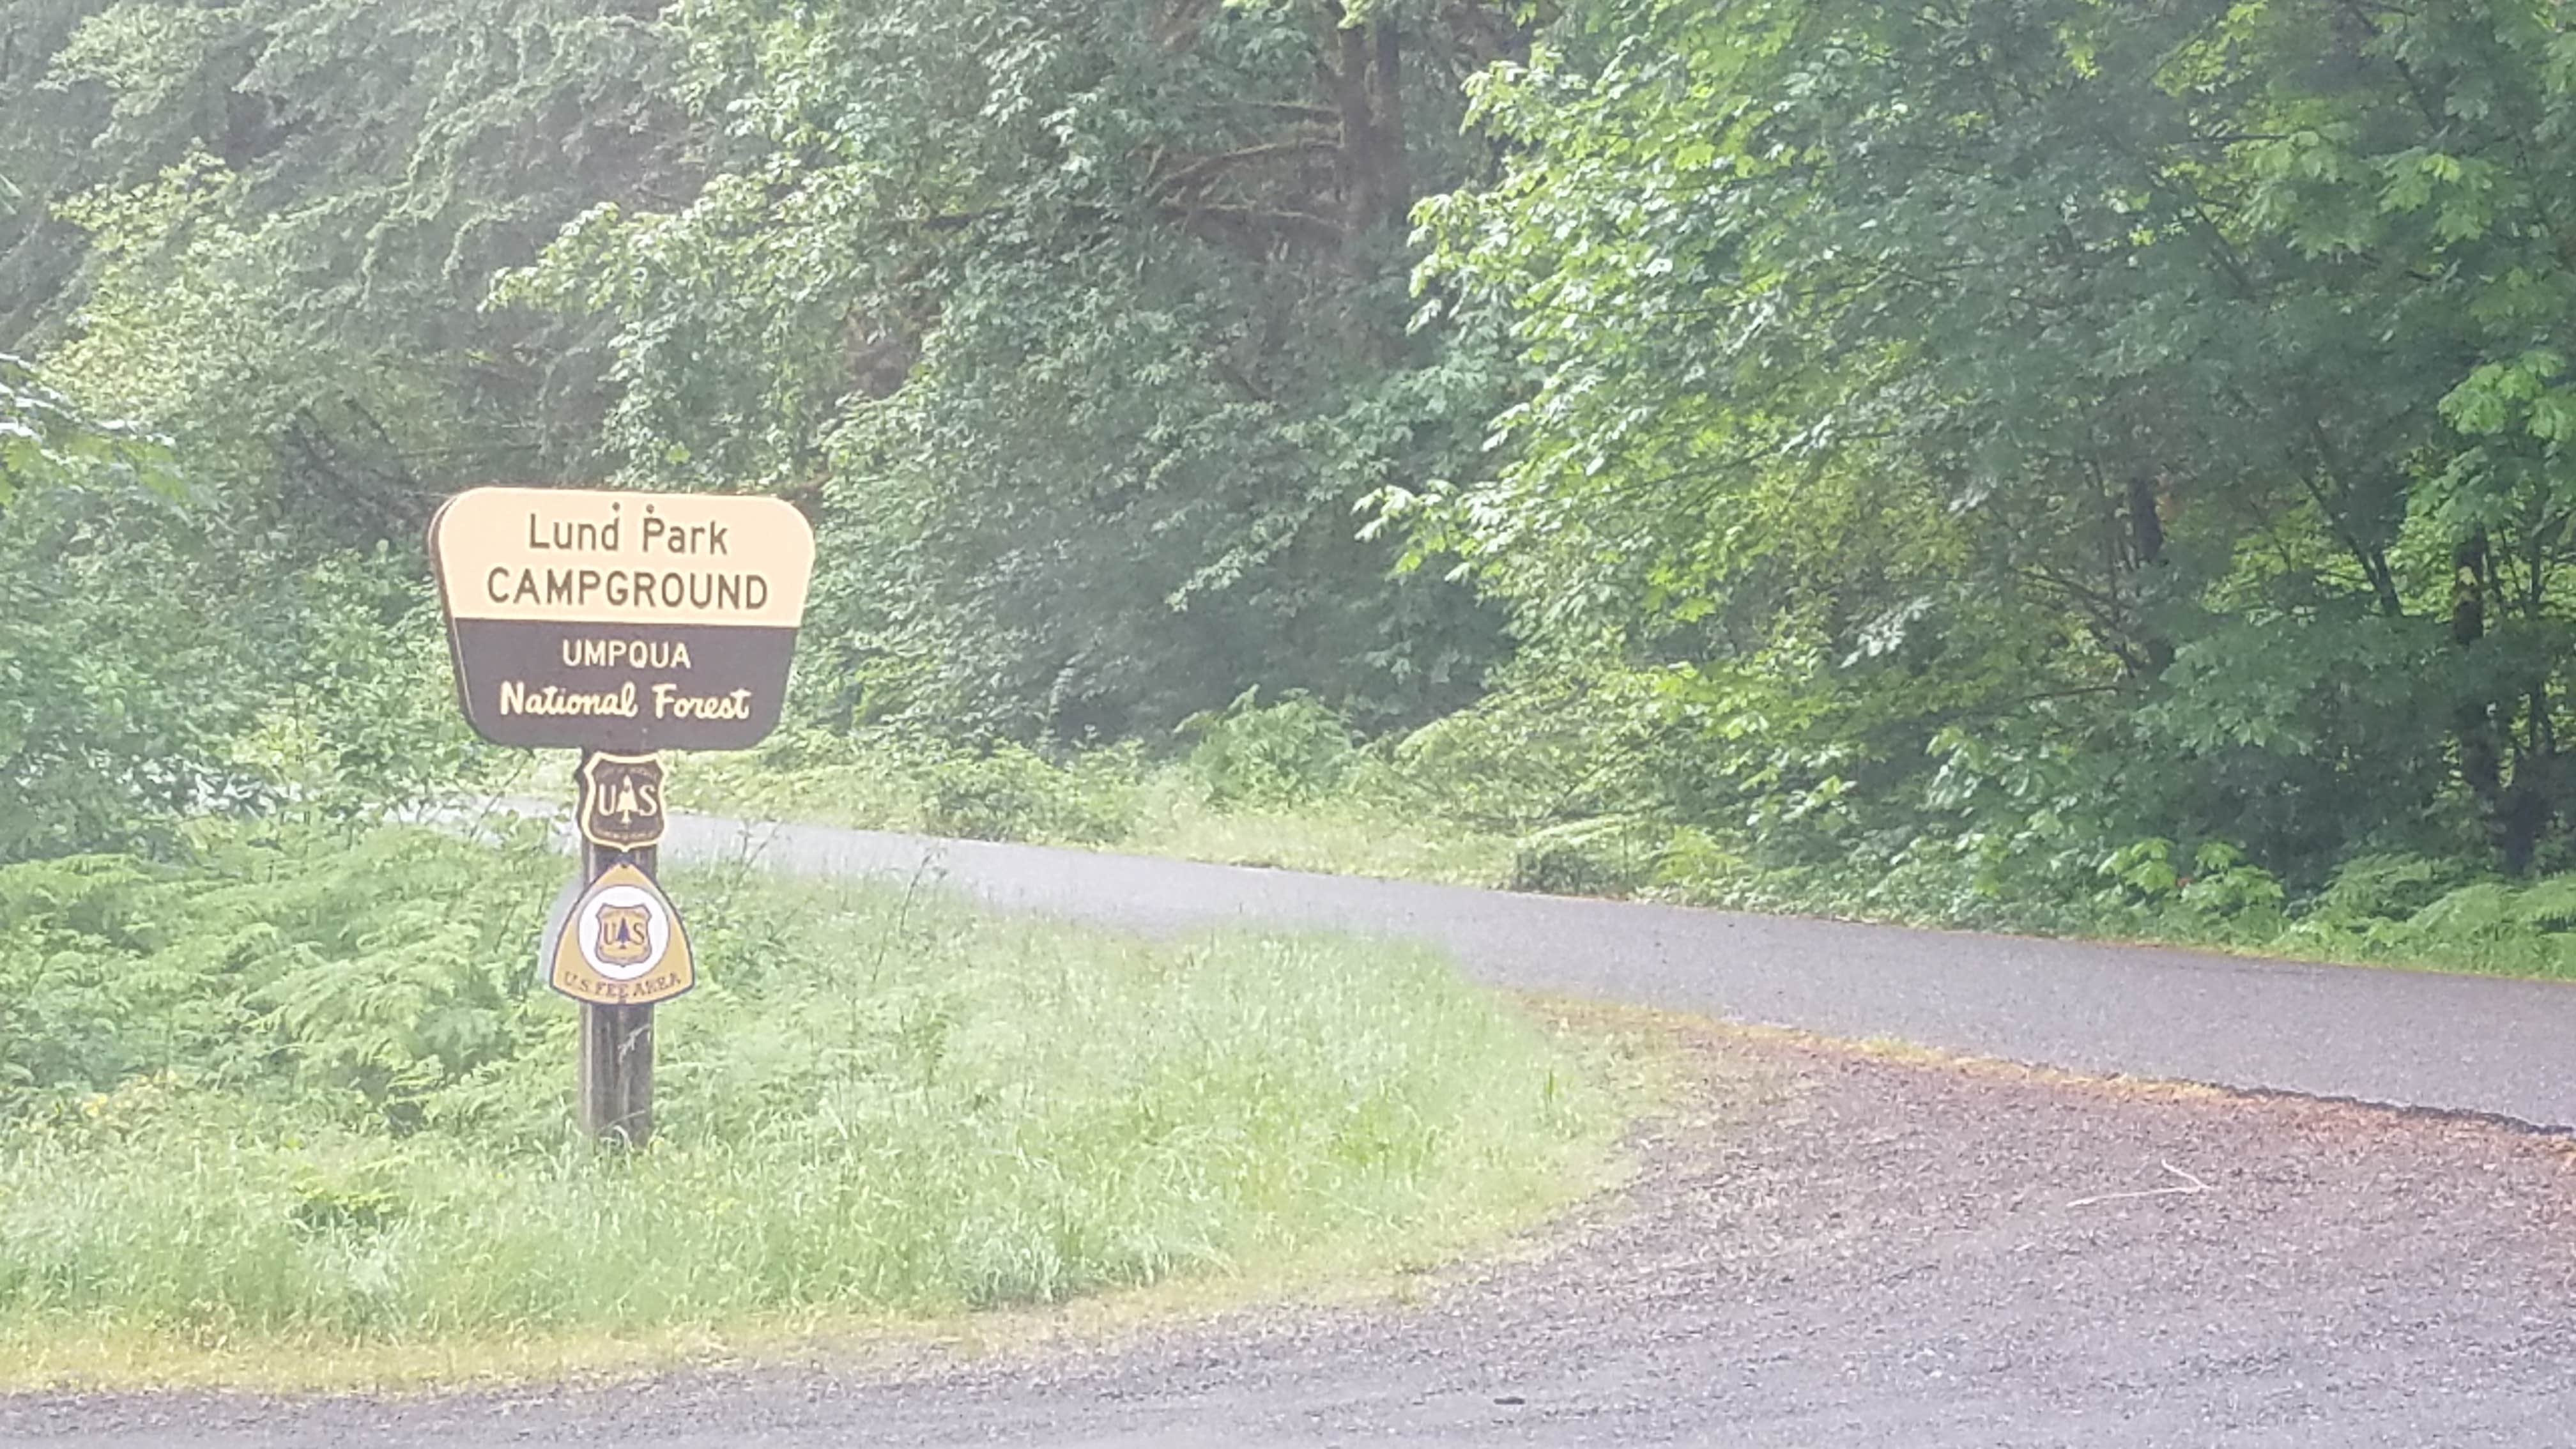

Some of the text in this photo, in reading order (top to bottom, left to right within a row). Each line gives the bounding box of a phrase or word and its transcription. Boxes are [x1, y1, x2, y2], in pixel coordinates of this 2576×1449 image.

[528, 514, 728, 555] Lund Park
[487, 567, 767, 609] CAMPGROUND
[563, 639, 691, 669] UMPQUA
[500, 680, 751, 719] National Forest
[594, 981, 628, 999] FEE
[632, 972, 681, 997] AREA
